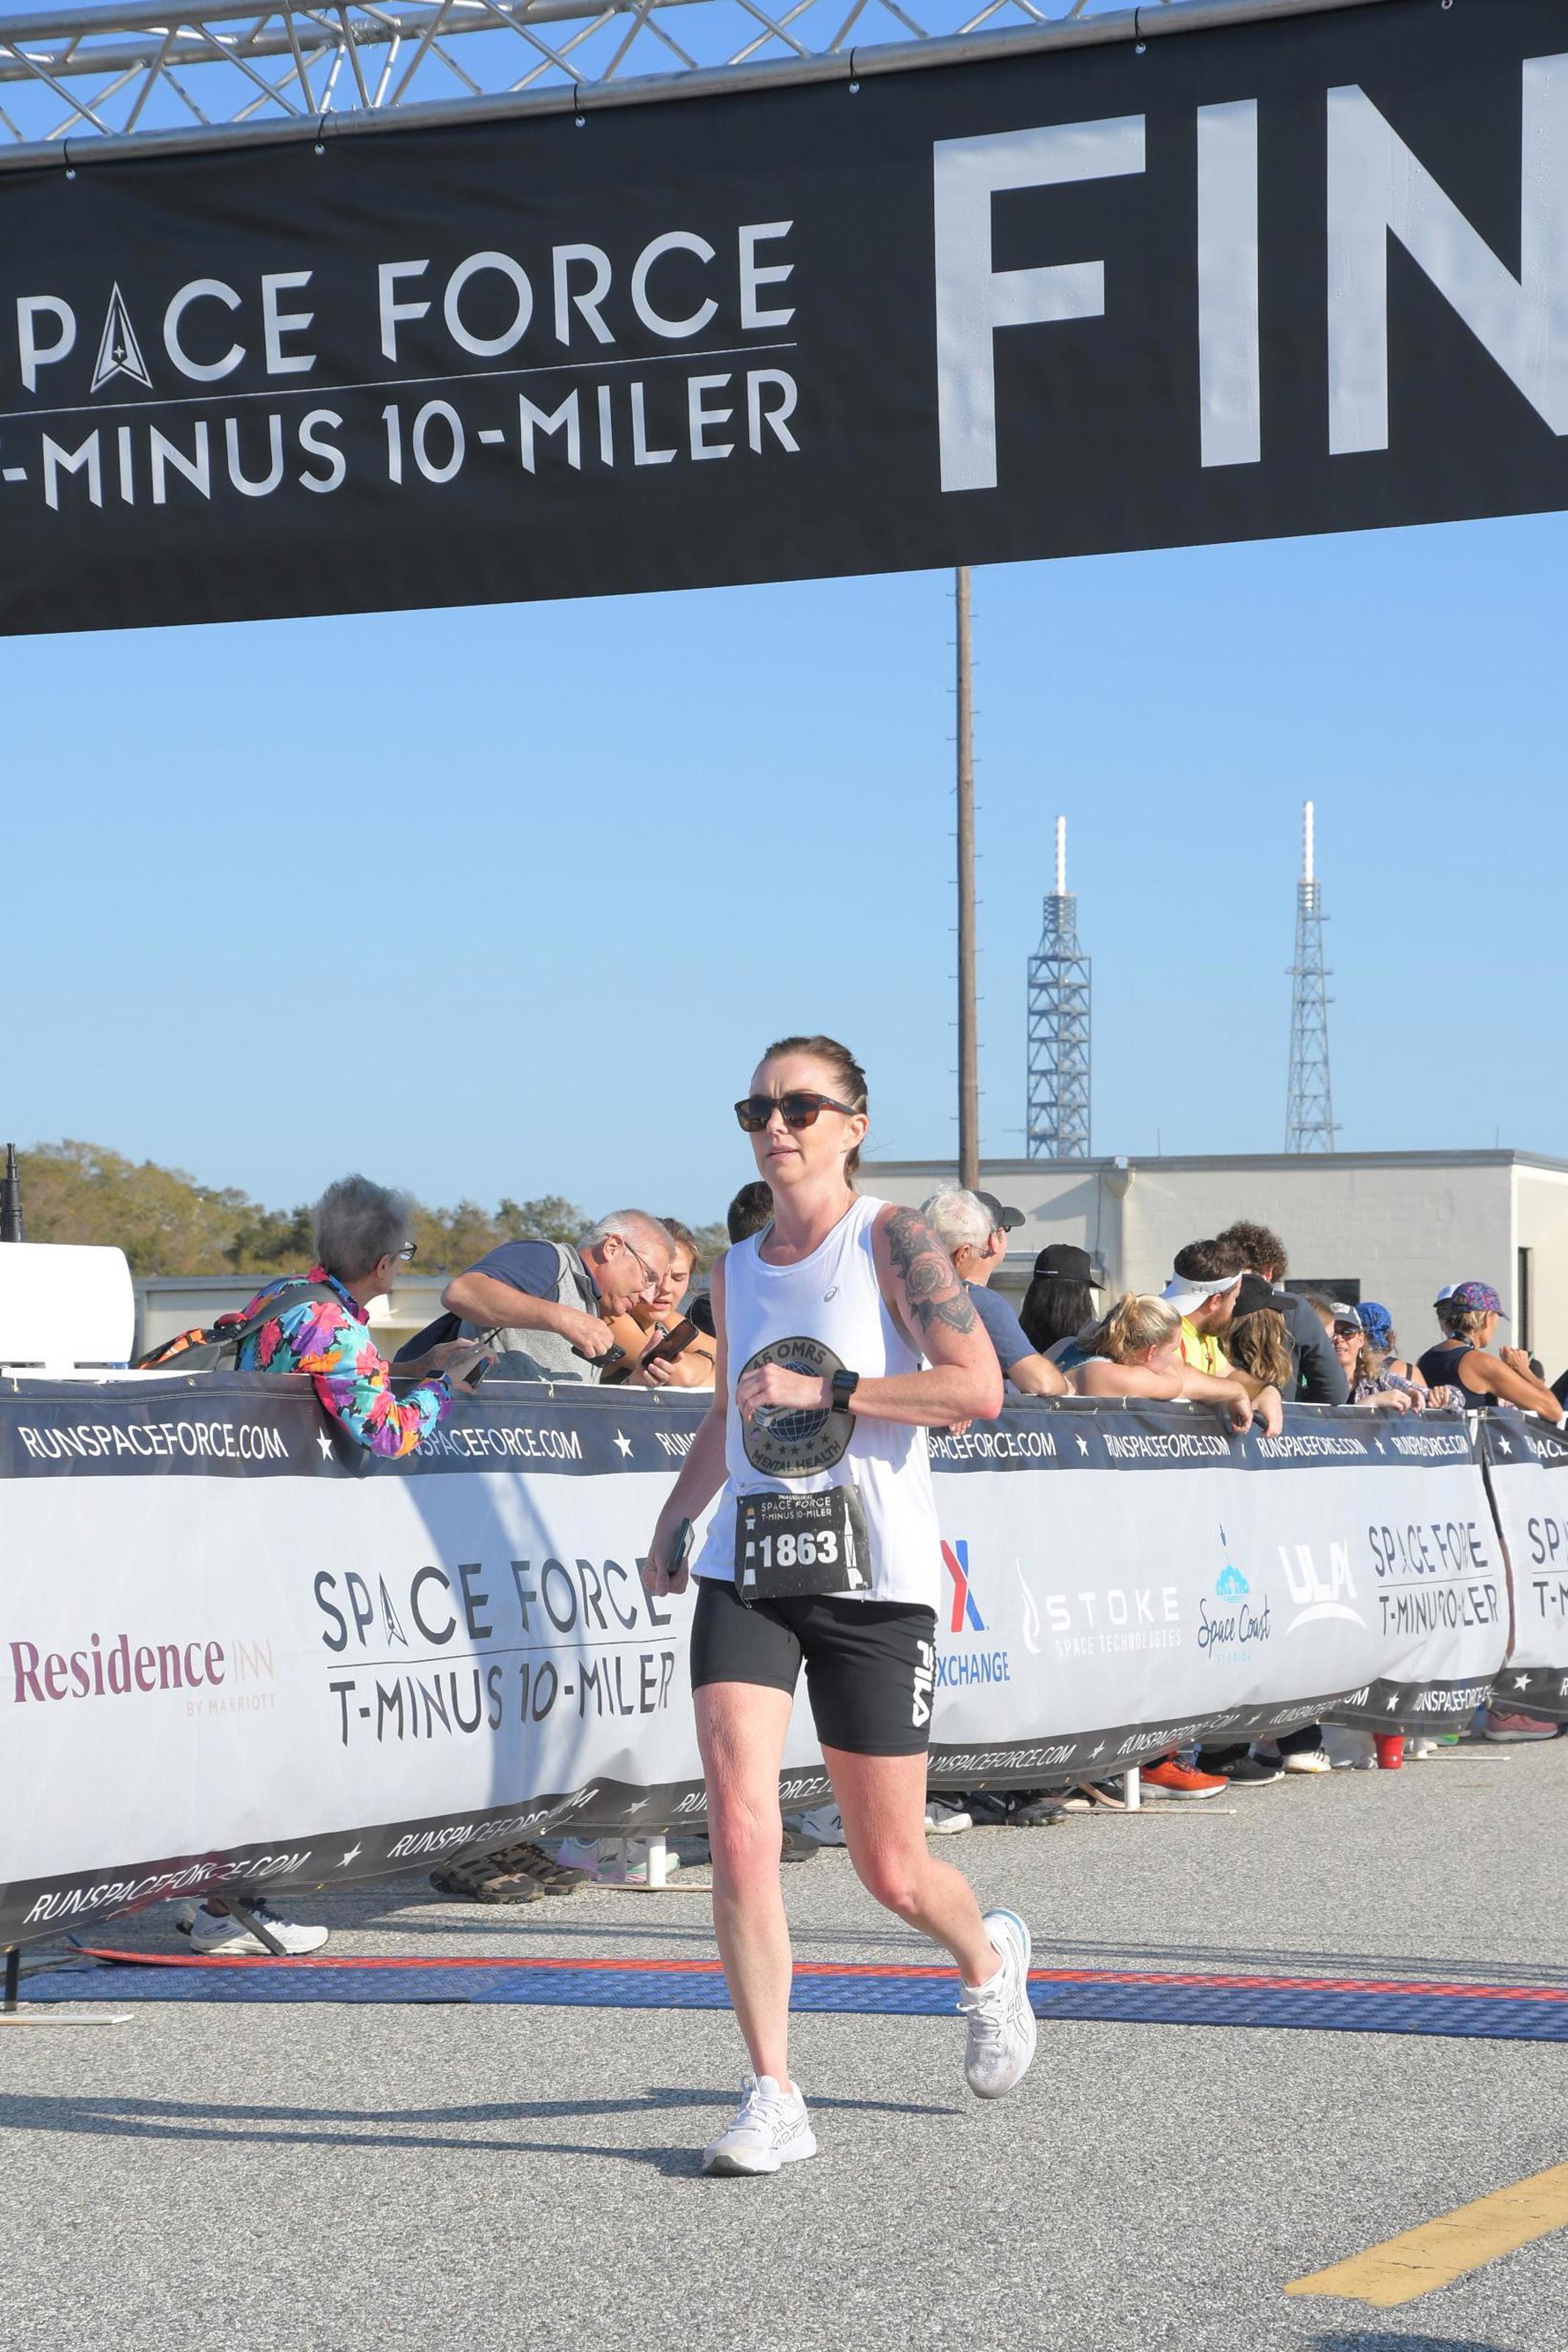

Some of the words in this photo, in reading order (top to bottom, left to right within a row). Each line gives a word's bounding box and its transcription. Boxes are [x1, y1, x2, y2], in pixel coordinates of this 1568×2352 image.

[378, 220, 796, 362] FORCE
[933, 52, 1568, 492] FIN
[381, 368, 801, 485] 10-MILER
[777, 1341, 827, 1365] OMRS
[18, 1422, 289, 1459] RUNSPACEFORCE.COM
[752, 1449, 791, 1471] MENTAL
[796, 1440, 841, 1471] HEALTH
[1103, 1433, 1231, 1459] RUNSPACEFORCE.COM
[1256, 1435, 1368, 1459] RUNSPACEFORCE.COM
[761, 1500, 791, 1512] SPACE
[795, 1496, 831, 1508] FORCE
[761, 1510, 794, 1521] T-MINUS
[759, 1530, 838, 1568] 1863
[1278, 1536, 1359, 1604] ULA
[314, 1562, 493, 1652] SPACE
[1046, 1586, 1181, 1632] STOKE
[1198, 1598, 1235, 1659] Space
[1239, 1593, 1271, 1643] Coast
[1055, 1636, 1094, 1658] SPACE
[1099, 1629, 1182, 1654] TECHNOLOGIES
[9, 1632, 226, 1703] Residence
[231, 1637, 276, 1682] INN
[187, 1702, 202, 1717] BY
[209, 1693, 276, 1715] MARRIOTT
[329, 1664, 503, 1747] T-MINUS
[518, 1651, 675, 1724] 10-MILER
